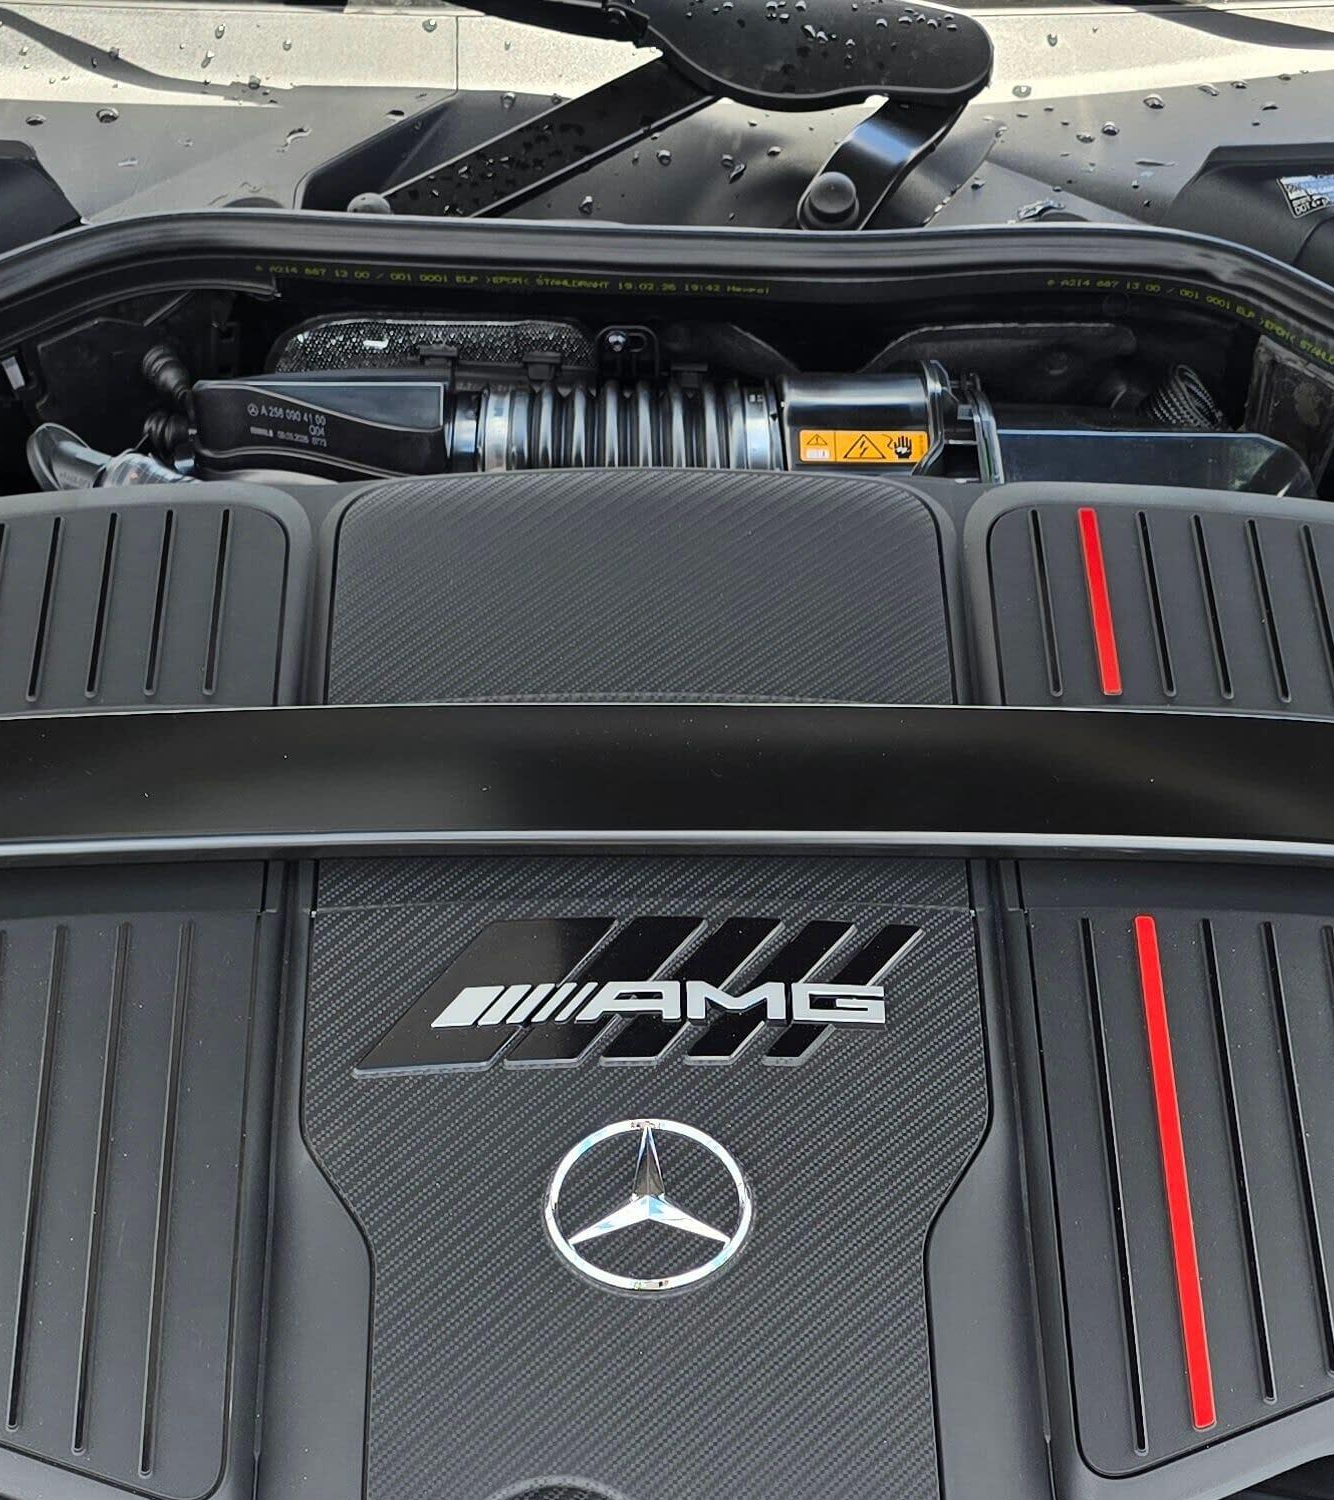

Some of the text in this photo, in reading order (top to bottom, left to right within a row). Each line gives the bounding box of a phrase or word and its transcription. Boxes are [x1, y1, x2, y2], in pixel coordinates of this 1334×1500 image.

[1294, 203, 1311, 216] DOT
[354, 270, 371, 280] 00
[1060, 278, 1091, 288] A214
[1144, 283, 1162, 293] 00
[575, 980, 887, 1024] AMG
